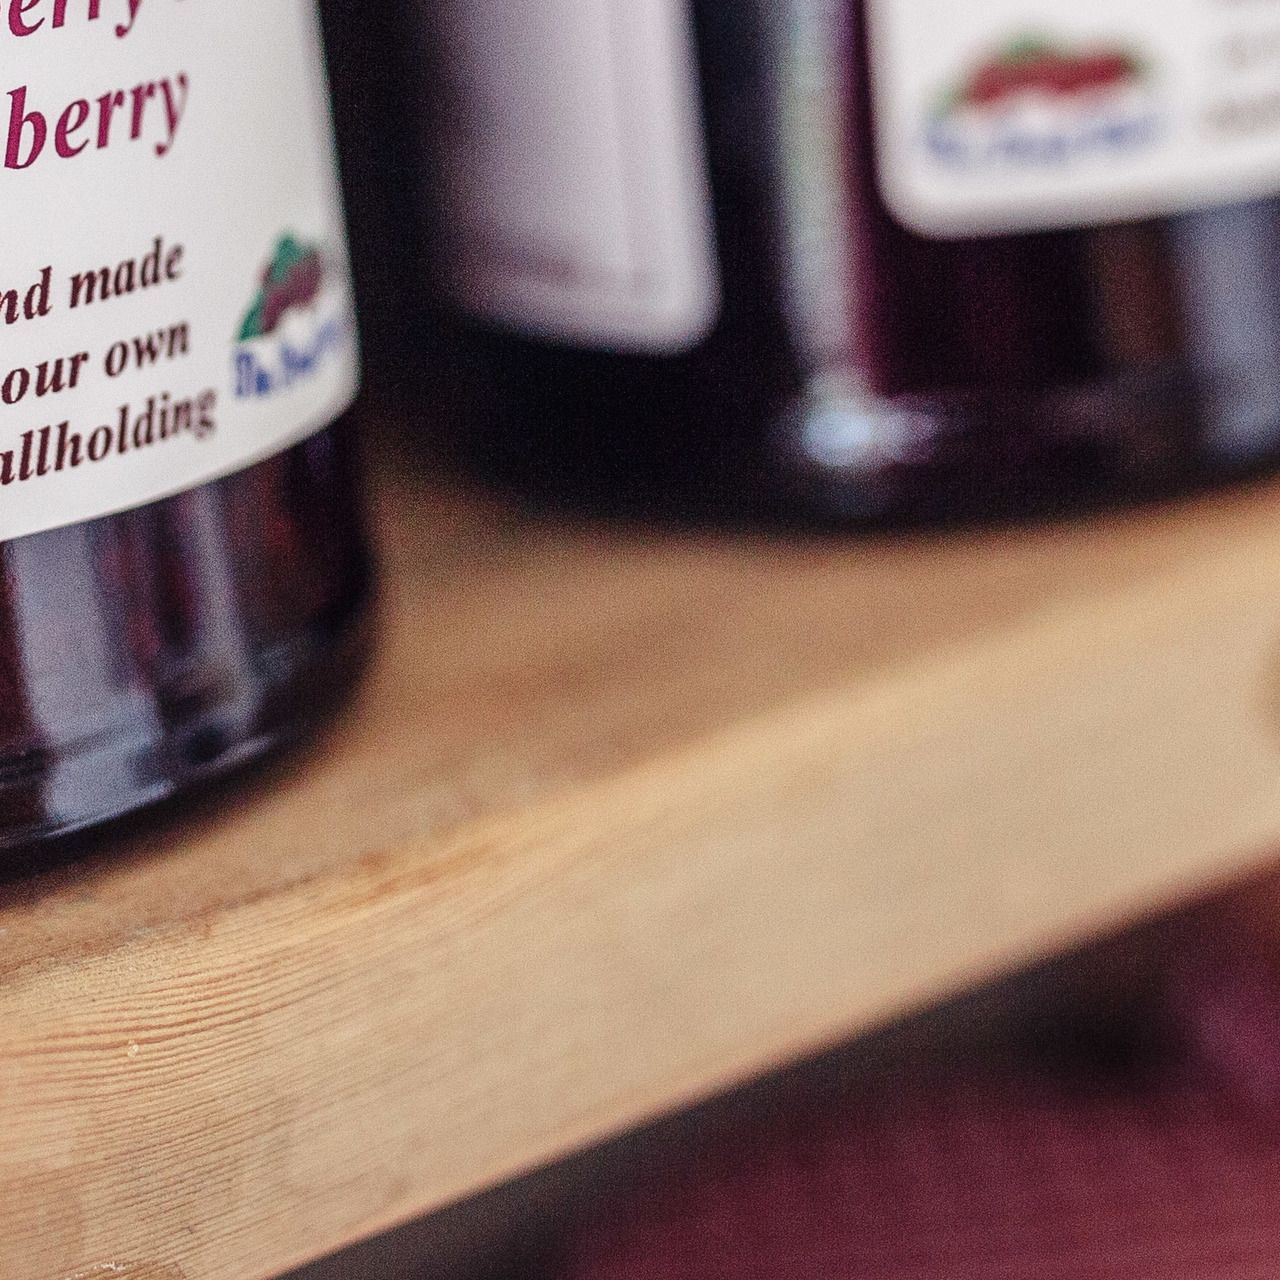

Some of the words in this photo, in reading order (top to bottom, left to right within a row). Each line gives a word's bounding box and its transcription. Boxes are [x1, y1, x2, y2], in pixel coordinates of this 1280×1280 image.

[68, 234, 185, 310] made
[0, 350, 90, 406] our
[103, 319, 192, 378] own
